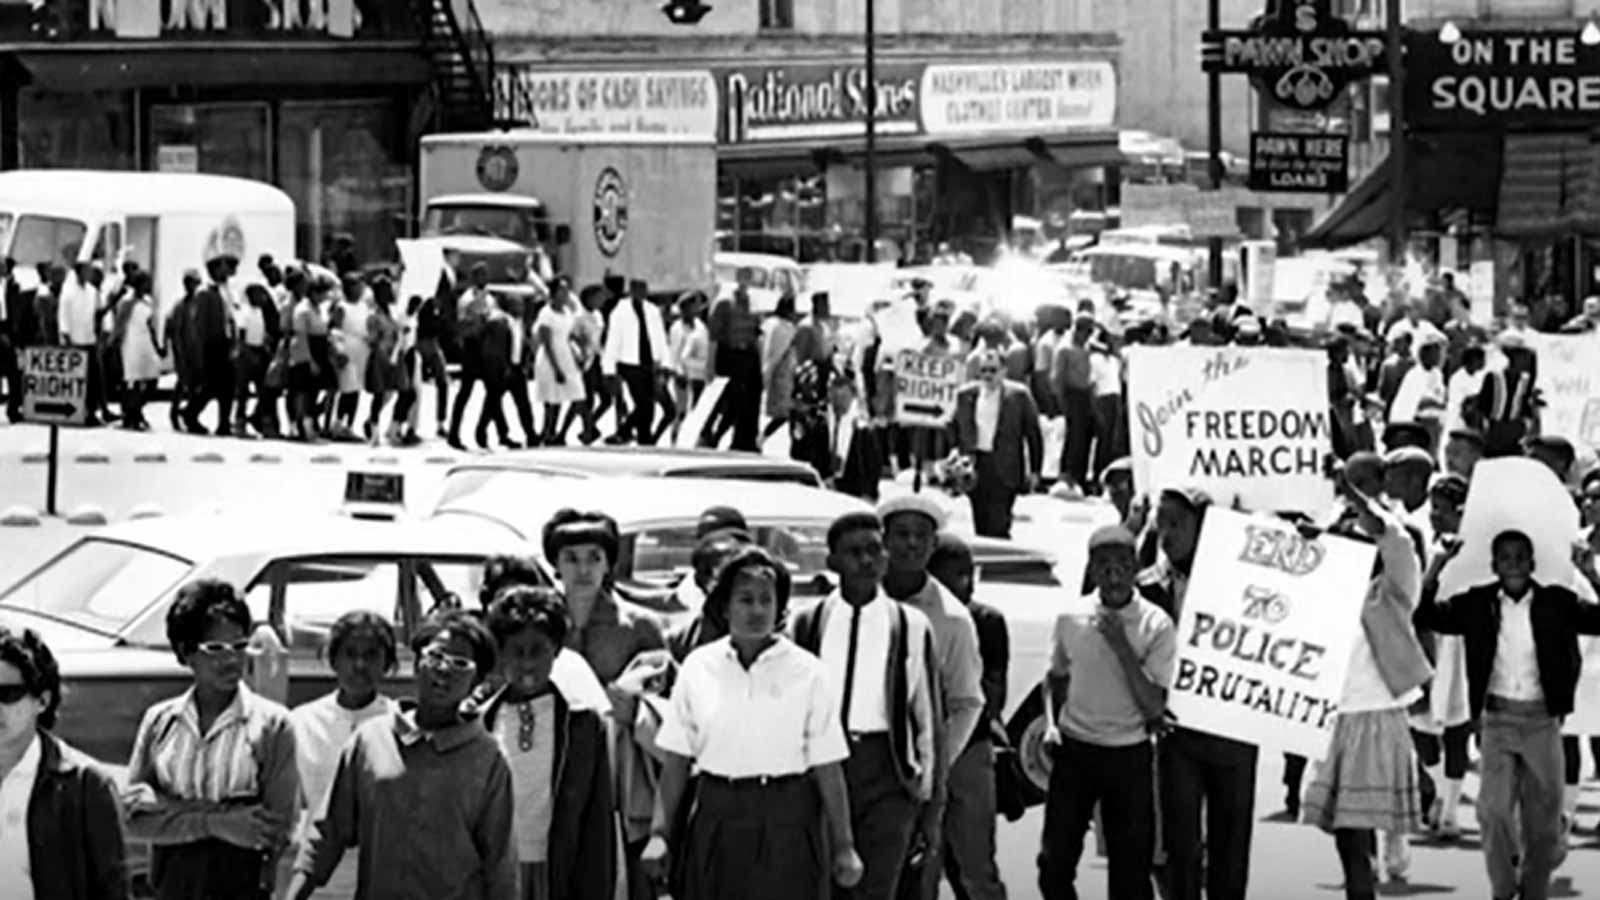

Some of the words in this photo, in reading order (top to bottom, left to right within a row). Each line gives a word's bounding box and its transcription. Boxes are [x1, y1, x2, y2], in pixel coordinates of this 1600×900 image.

[1225, 37, 1304, 67] PAWN
[1309, 37, 1384, 67] SHOP
[1452, 37, 1494, 65] ON
[1505, 37, 1576, 65] THE
[577, 77, 598, 110] OF
[602, 76, 641, 109] CASH
[646, 74, 708, 108] SAVINGS
[729, 71, 841, 142] National
[847, 67, 916, 118] Stres
[1431, 75, 1600, 116] SQUARE
[1255, 137, 1300, 156] PAWN
[1305, 137, 1343, 158] HERE
[1271, 171, 1328, 188] LOANS
[30, 350, 82, 373] KEEP
[902, 355, 955, 379] KEEP
[23, 375, 88, 398] RIGHT
[897, 378, 958, 403] RIGHT
[1136, 387, 1194, 458] Join
[1203, 352, 1250, 386] the
[1185, 409, 1331, 440] FREEDOM
[1188, 445, 1318, 478] MARCH
[1238, 524, 1327, 577] END
[1242, 583, 1291, 624] TO
[1188, 611, 1327, 681] POLICE
[1174, 657, 1338, 729] BRUTALITY
